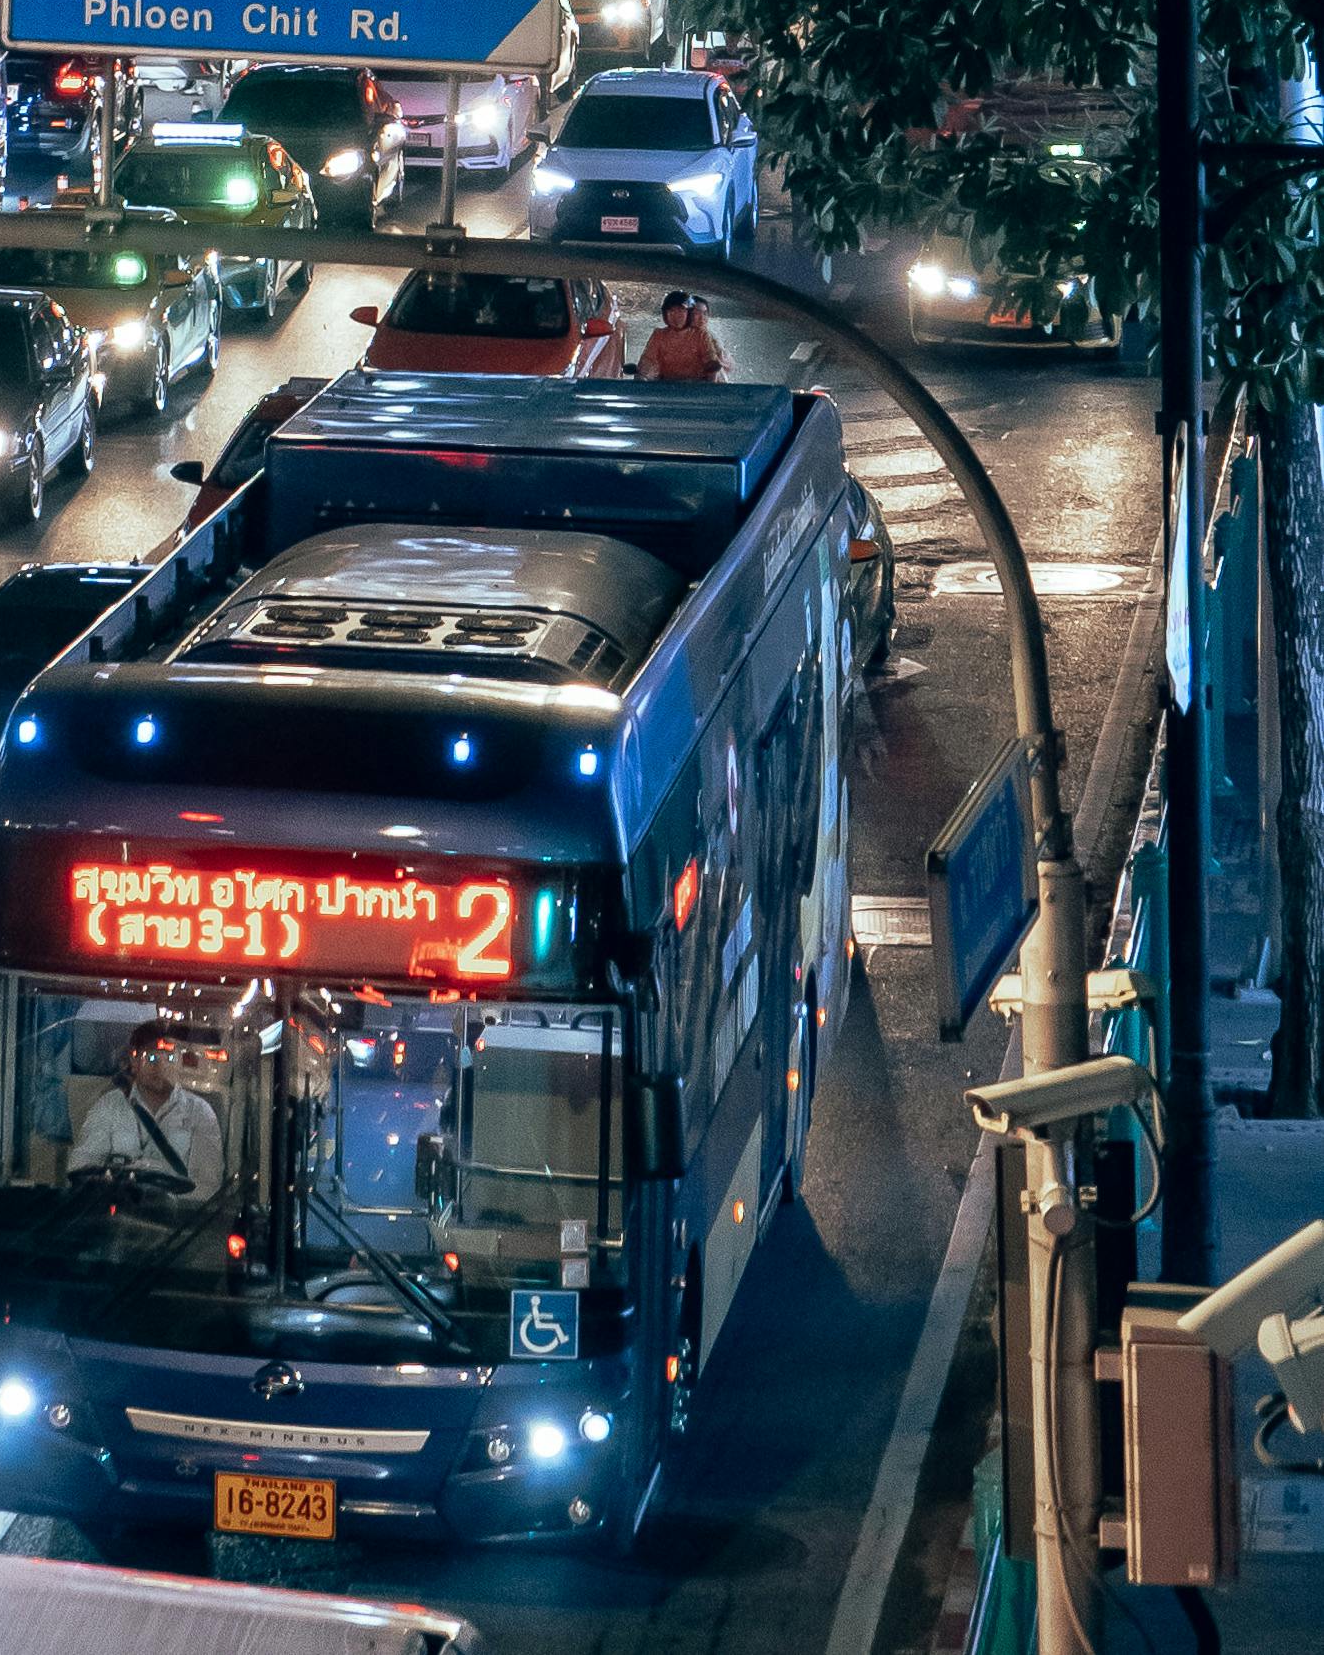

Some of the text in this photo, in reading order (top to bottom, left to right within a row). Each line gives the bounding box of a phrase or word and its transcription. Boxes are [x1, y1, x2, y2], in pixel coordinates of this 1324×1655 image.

[241, 2, 319, 38] Chit
[349, 7, 409, 43] Rd.
[211, 871, 305, 913] อโศก
[456, 884, 512, 976] 2
[226, 1486, 328, 1522] 16-8243
[243, 1477, 307, 1493] THAILAND
